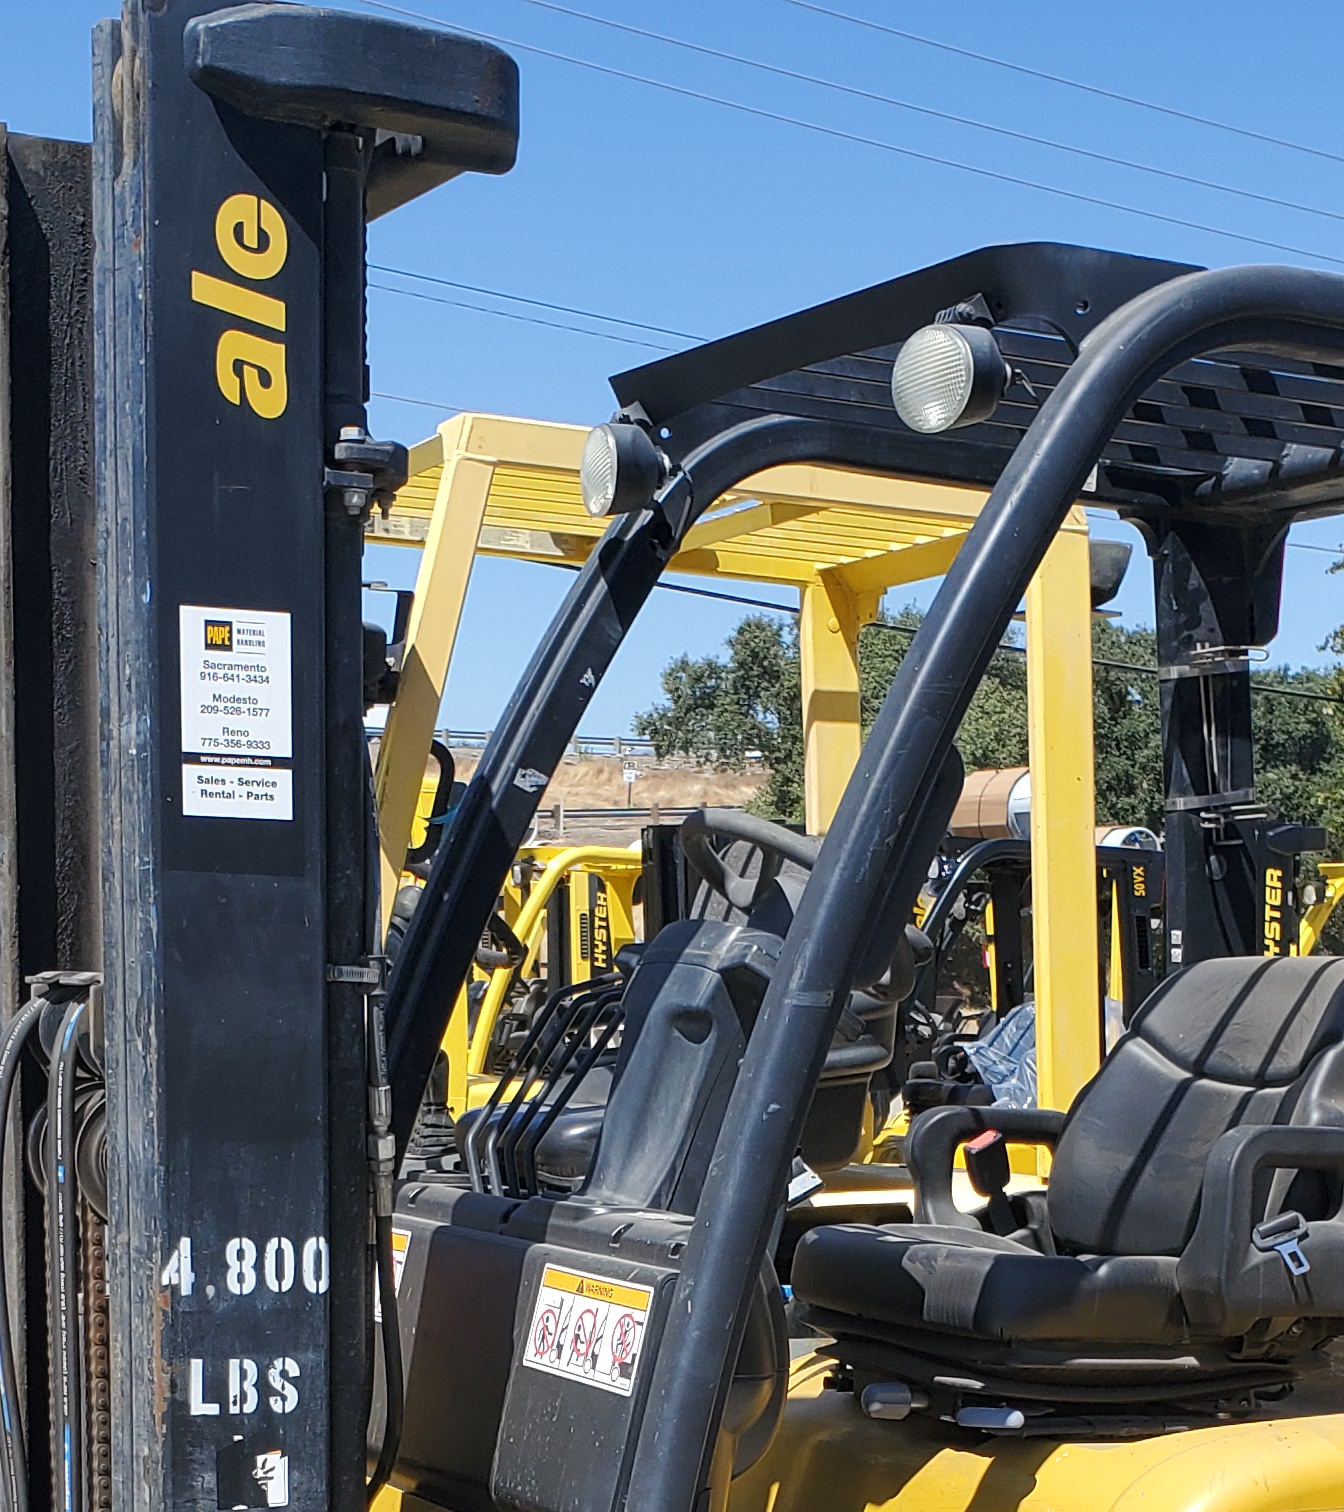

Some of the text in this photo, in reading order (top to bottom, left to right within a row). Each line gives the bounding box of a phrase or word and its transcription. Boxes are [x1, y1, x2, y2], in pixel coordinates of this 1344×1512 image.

[191, 192, 289, 420] ale
[237, 628, 265, 637] MATERIAL
[203, 660, 267, 673] Sacramento
[200, 671, 270, 684] 916-641-3434
[212, 693, 258, 705] Modesto
[200, 705, 270, 717] 209-526-1577
[222, 726, 250, 737] Reno
[200, 737, 271, 750] 775-356-9333
[197, 775, 226, 786] Sales
[237, 777, 277, 788] Service
[200, 788, 235, 799] Rental
[247, 791, 275, 801] Parts
[1133, 866, 1146, 897] 50VX
[594, 891, 607, 968] HYSTER
[585, 1283, 614, 1298] WARNING
[190, 1357, 301, 1416] LBS
